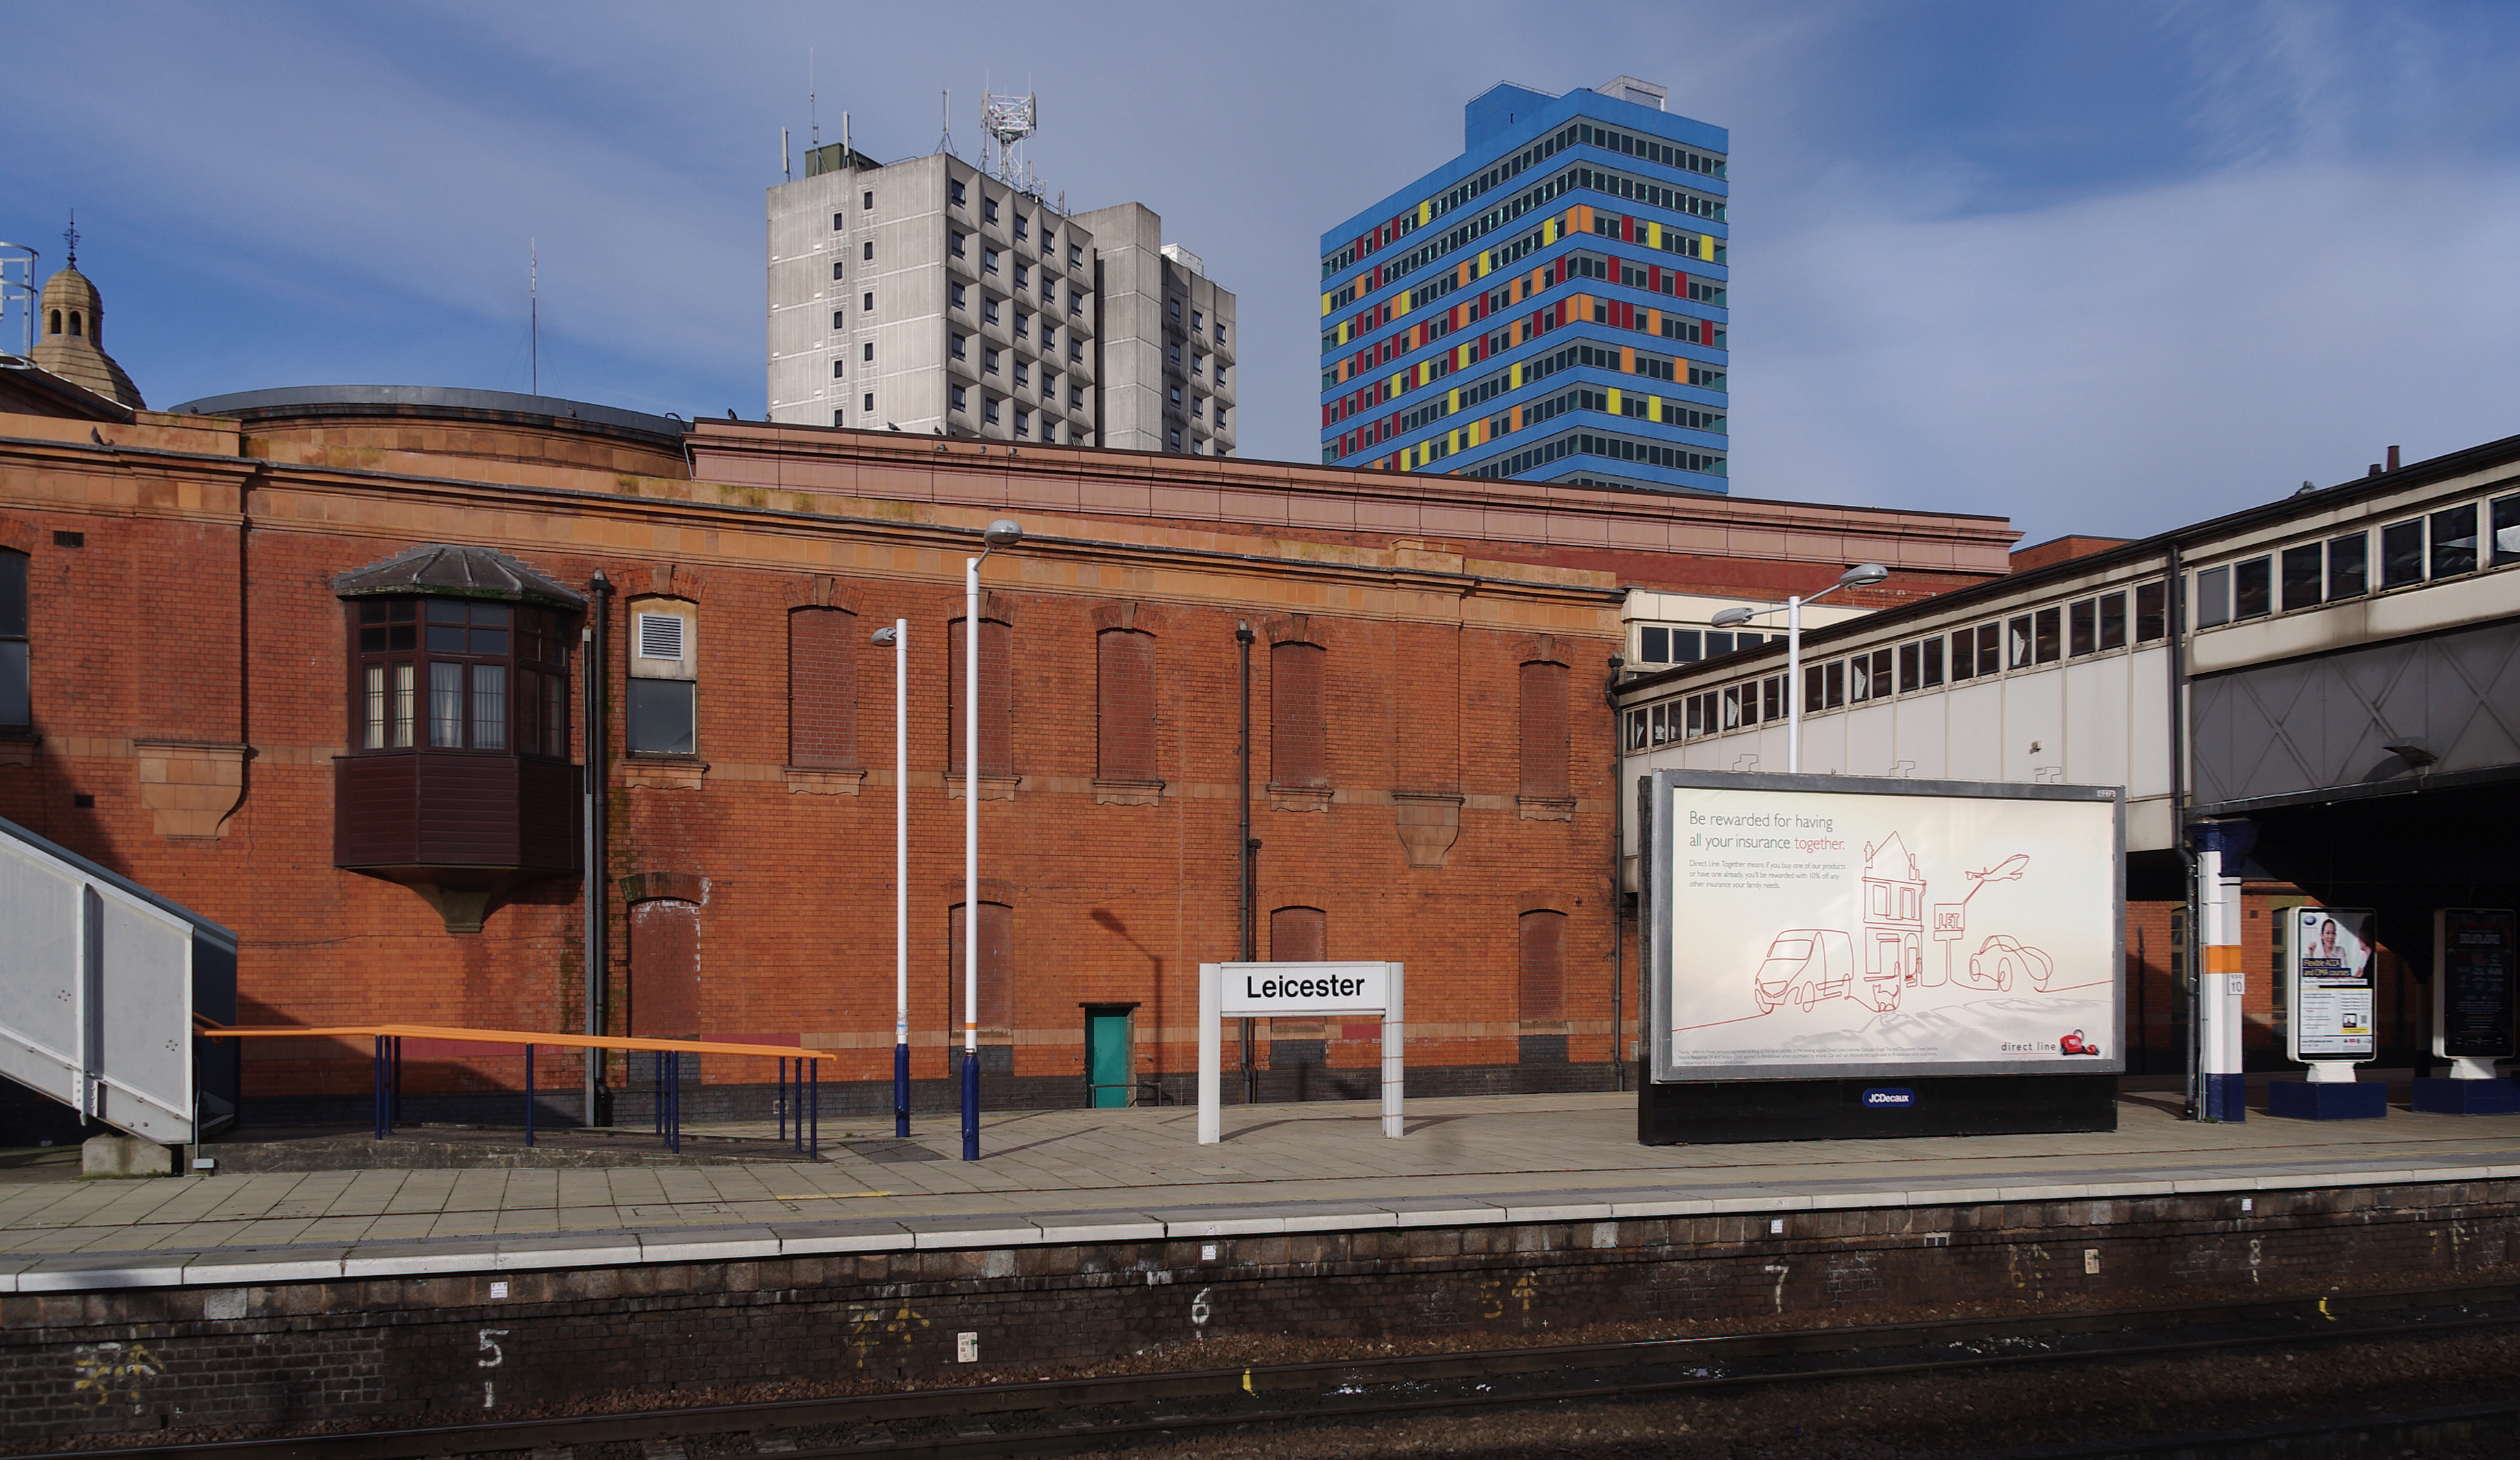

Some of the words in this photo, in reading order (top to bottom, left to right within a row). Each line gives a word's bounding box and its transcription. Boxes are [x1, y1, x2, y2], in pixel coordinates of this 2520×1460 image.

[1690, 810, 1705, 825] Be
[1710, 812, 1770, 827] rewarded
[1774, 813, 1792, 828] for
[1796, 814, 1834, 832] having
[1690, 832, 1701, 847] all
[1705, 837, 1733, 851] your
[1735, 834, 1790, 849] insurance
[1794, 836, 1845, 854] together.
[1721, 860, 1746, 869] Together
[1939, 913, 1960, 929] LET
[1247, 974, 1365, 998] Leicester
[2230, 982, 2242, 992] 10
[2001, 1042, 2033, 1051] direct
[2037, 1041, 2057, 1051] line
[1868, 1093, 1909, 1103] JCDecaux
[2250, 1239, 2262, 1265] 8
[1765, 1265, 1790, 1306] 7
[1192, 1287, 1210, 1324] 6
[1480, 1281, 1503, 1319] 5
[479, 1328, 509, 1367] 5
